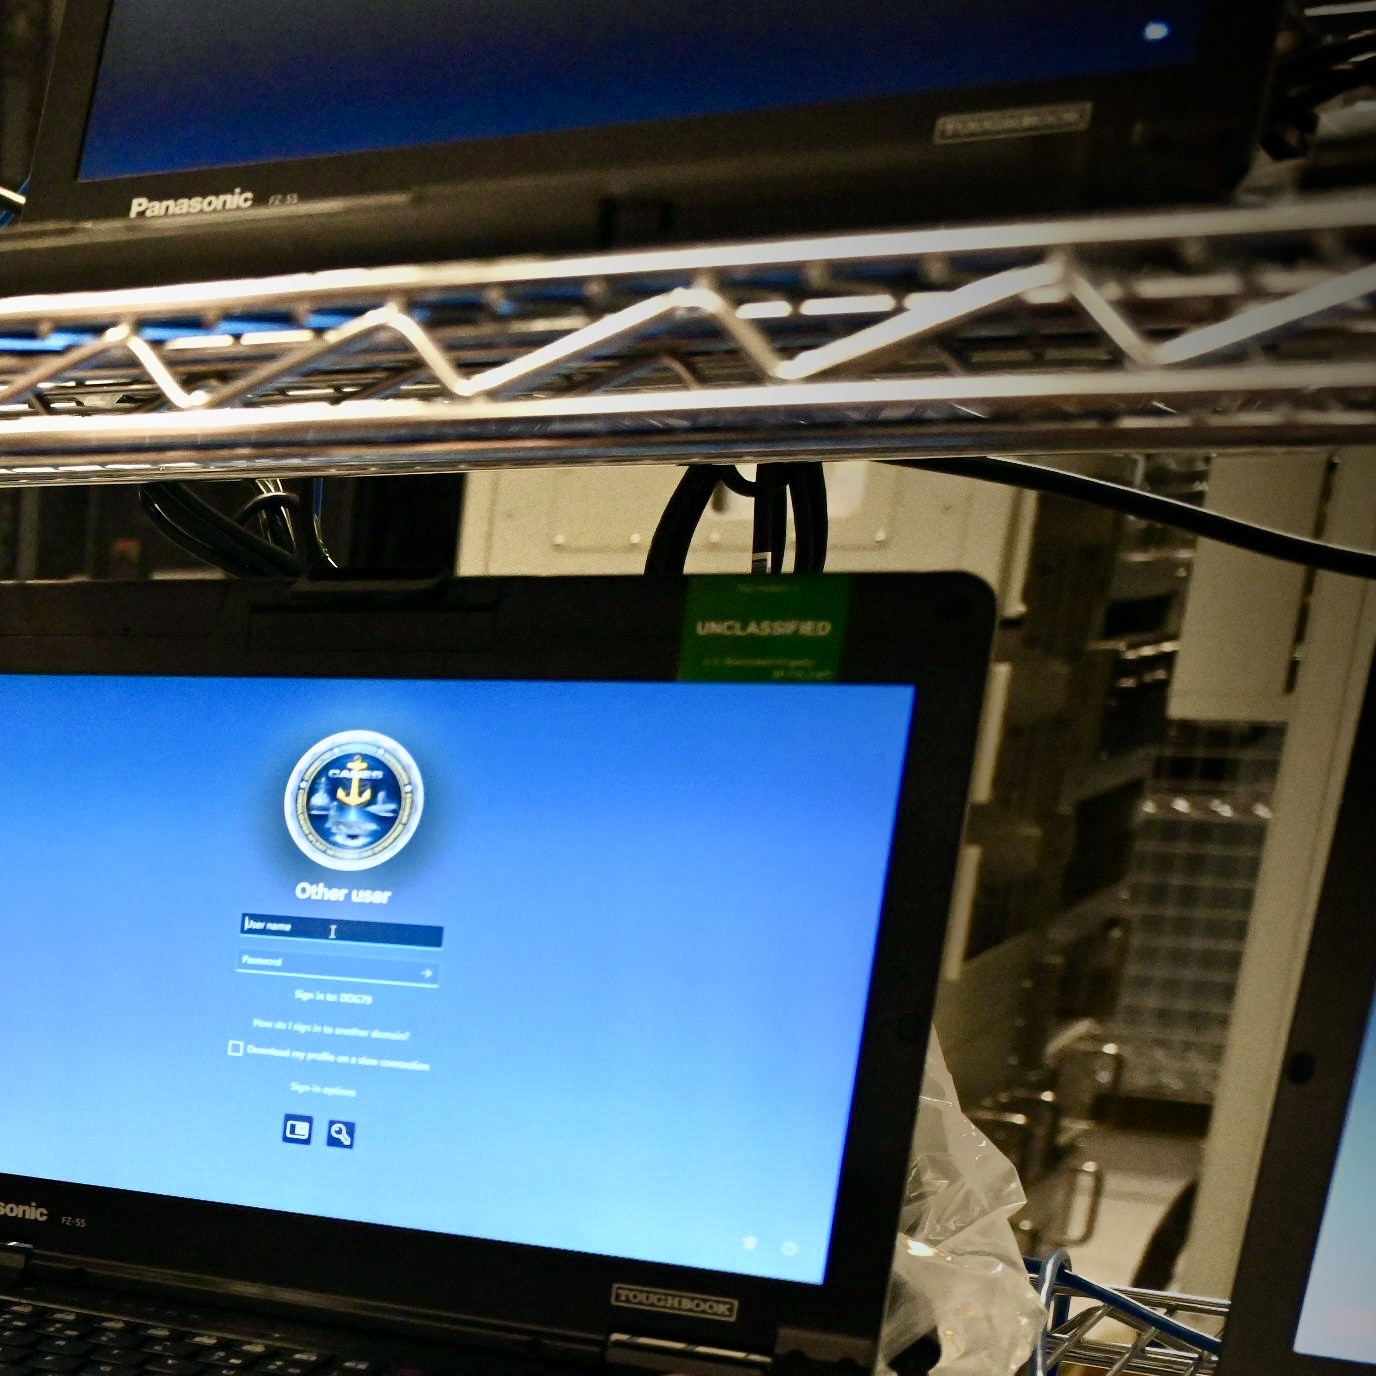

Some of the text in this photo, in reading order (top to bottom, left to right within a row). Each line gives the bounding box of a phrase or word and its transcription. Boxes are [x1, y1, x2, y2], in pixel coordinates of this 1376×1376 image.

[129, 187, 254, 219] Panasonic
[696, 620, 832, 636] UNCLASSIFIED
[295, 881, 392, 904] Other user
[246, 919, 292, 932] User name
[241, 954, 283, 967] Password
[295, 989, 314, 1002] Sign
[315, 990, 325, 1001] in
[61, 1216, 86, 1228] FZ-55
[617, 1288, 732, 1316] TOUGHBOOK
